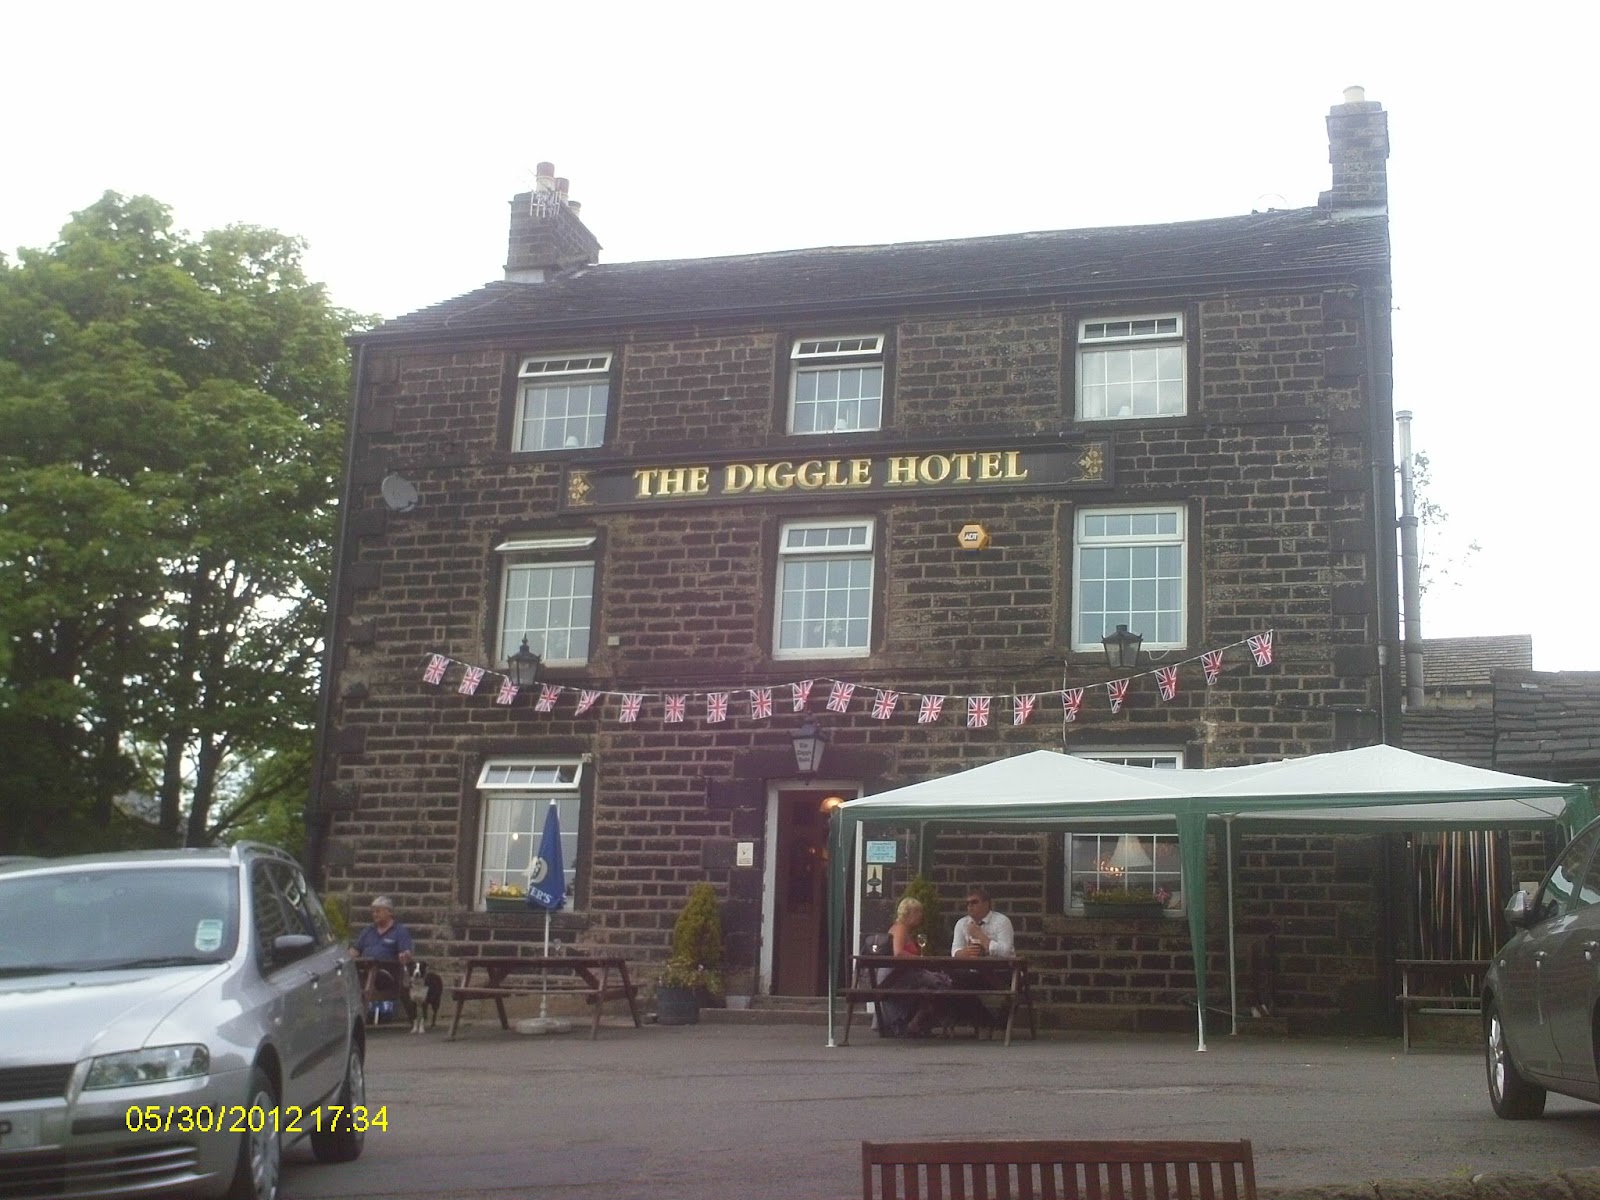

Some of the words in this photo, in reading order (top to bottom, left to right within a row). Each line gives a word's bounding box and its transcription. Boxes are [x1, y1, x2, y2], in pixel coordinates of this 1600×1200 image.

[633, 465, 710, 497] THE
[722, 458, 872, 493] DIGGLE
[887, 450, 1029, 485] HOTEL
[964, 532, 978, 541] ADT
[529, 885, 552, 904] ER'S
